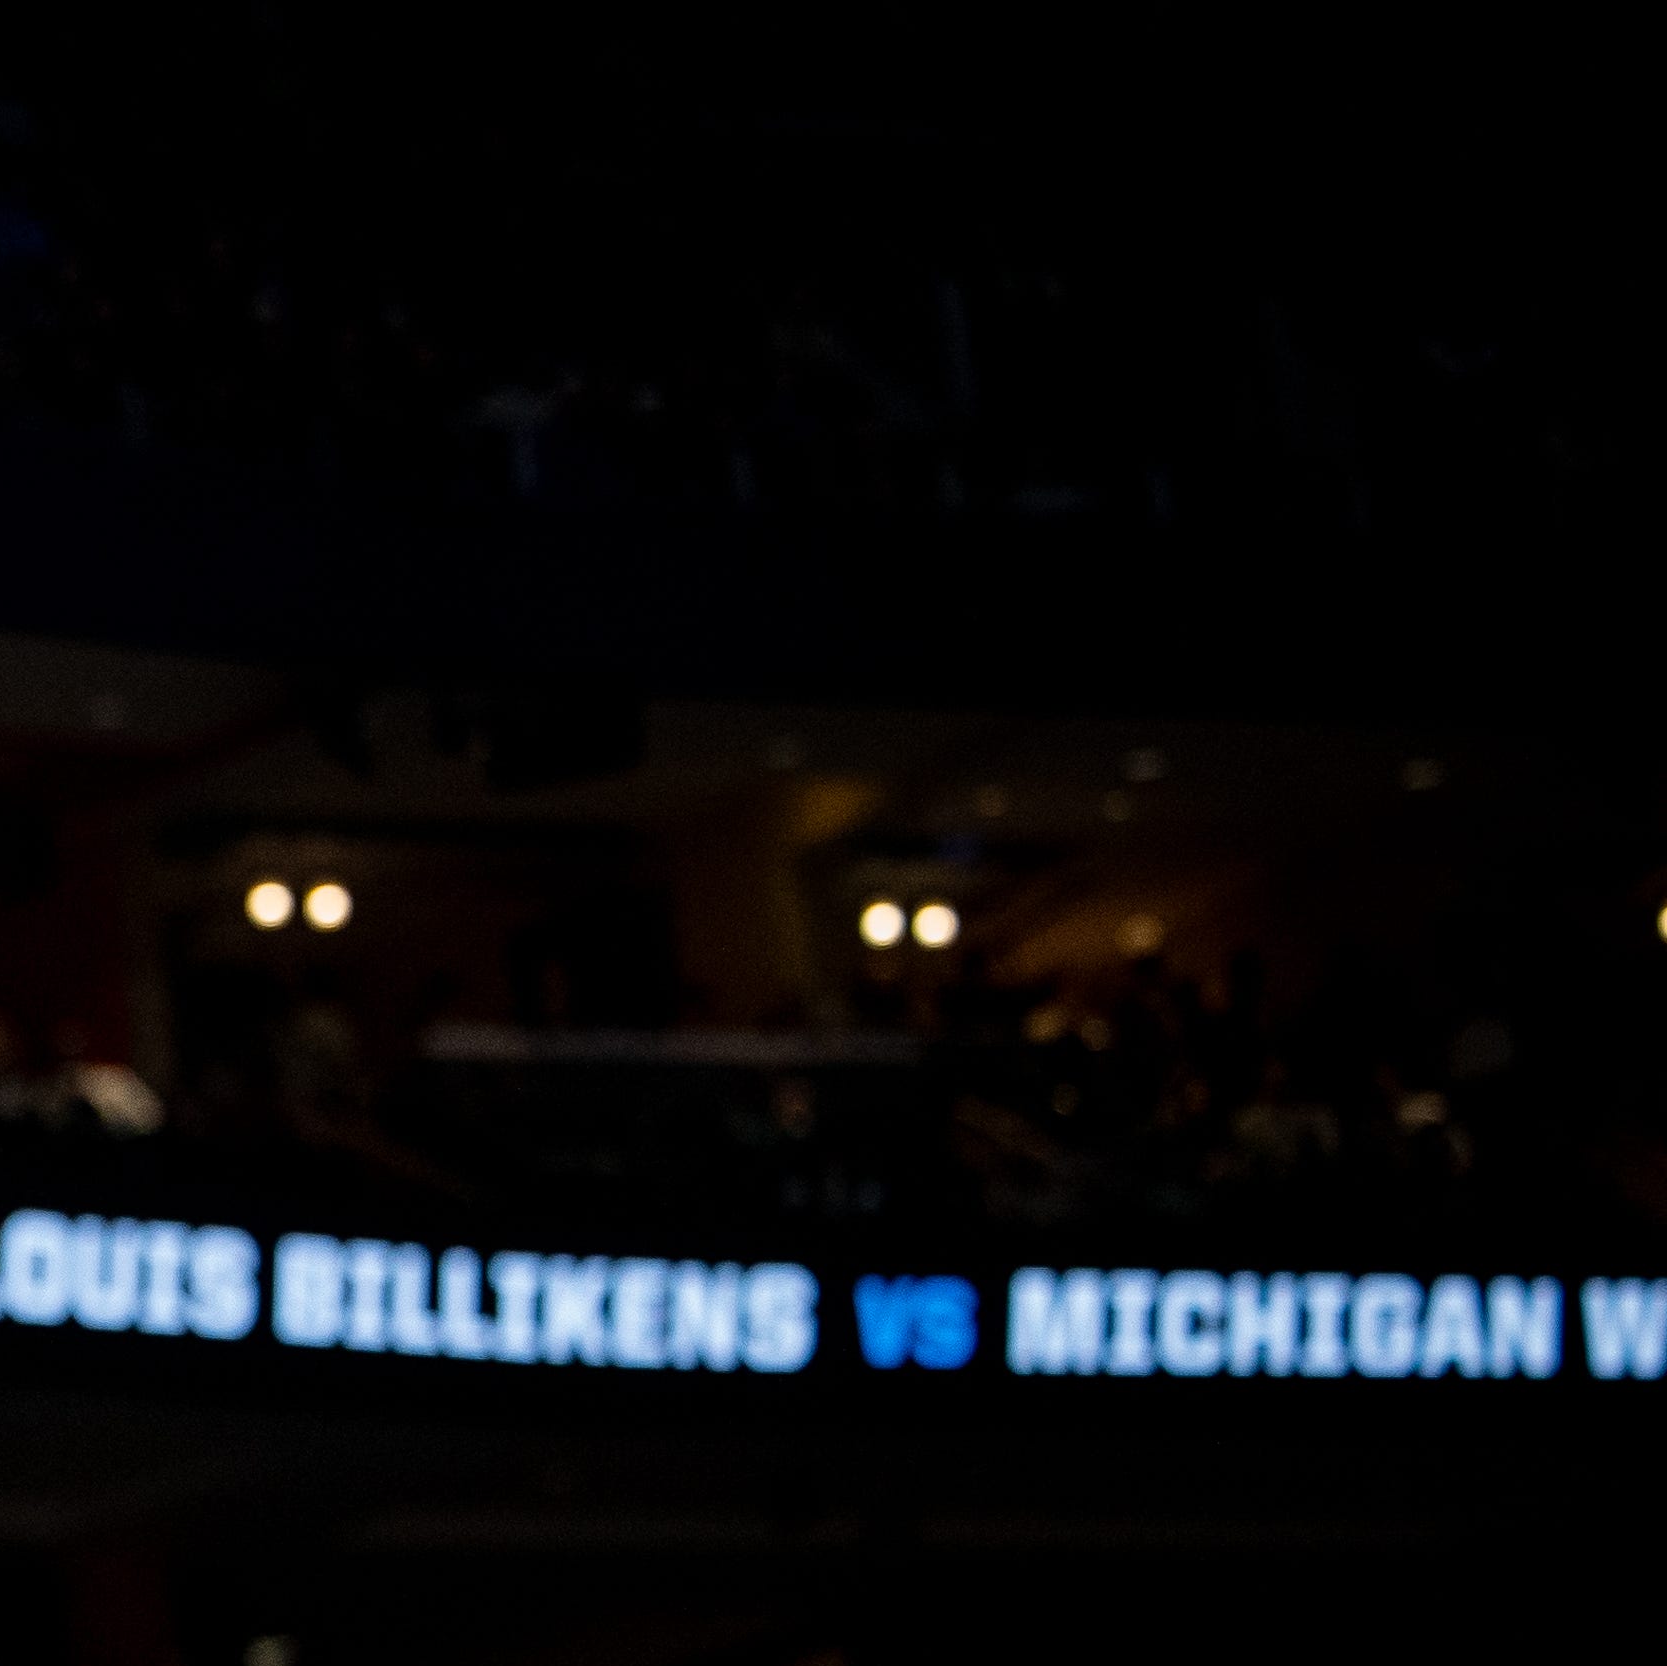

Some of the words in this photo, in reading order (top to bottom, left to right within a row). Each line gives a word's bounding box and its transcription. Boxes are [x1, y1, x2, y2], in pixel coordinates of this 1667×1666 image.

[273, 1233, 819, 1373] BILLIKENS
[854, 1275, 978, 1369] VS
[1007, 1267, 1564, 1378] MICHIGAN
